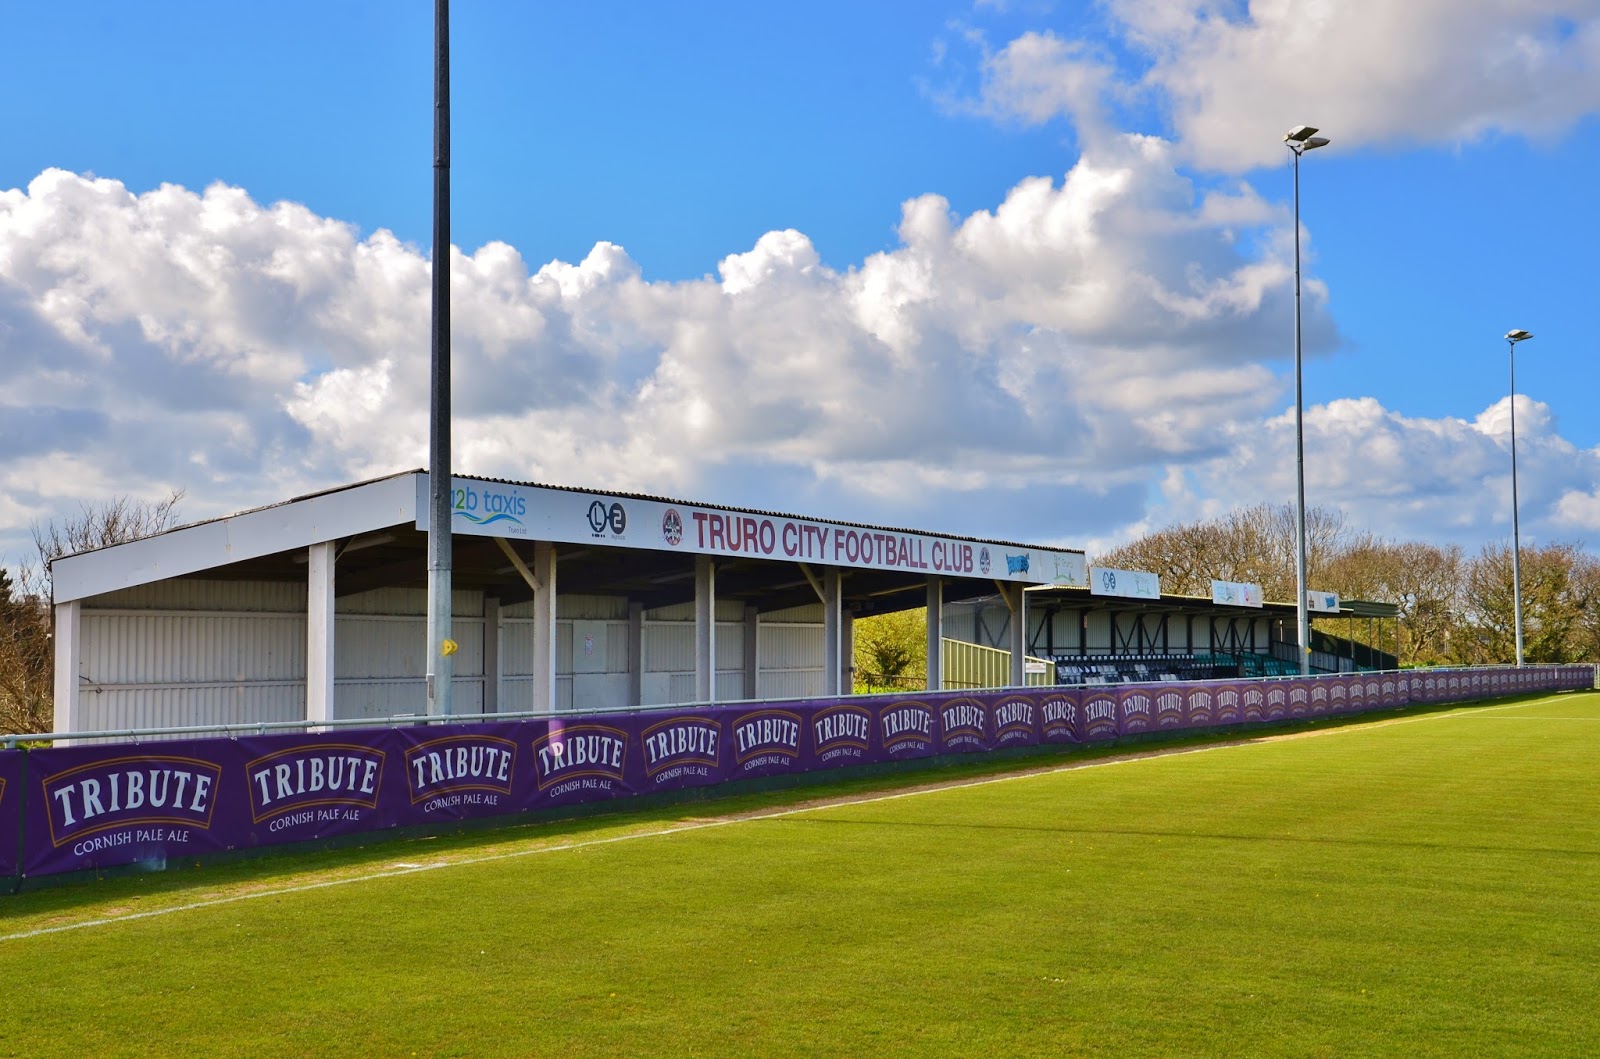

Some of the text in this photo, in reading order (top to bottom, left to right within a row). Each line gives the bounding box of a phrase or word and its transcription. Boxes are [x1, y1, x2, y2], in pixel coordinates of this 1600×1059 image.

[483, 490, 526, 516] taxis
[692, 512, 776, 555] TRURO
[782, 522, 829, 559] CITY
[834, 529, 928, 569] FOOTBALL
[932, 541, 974, 573] CLUB
[1043, 701, 1075, 724] TRIBUTE
[1085, 700, 1115, 723] TRIBUTE
[1123, 695, 1149, 717] TRIBUTE
[1157, 693, 1182, 713] TRIBUTE
[1189, 692, 1211, 711] TRIBUTE
[882, 709, 930, 738] TRIBUTE
[943, 706, 984, 732] TRIBUTE
[996, 703, 1033, 728] TRIBUTE
[736, 719, 798, 753] TRIBUTE
[815, 713, 868, 744] TRIBUTE
[538, 735, 623, 776] TRIBUTE
[646, 726, 718, 764] TRIBUTE
[822, 749, 841, 761] CORNISH
[842, 748, 852, 756] PALE
[889, 742, 907, 754] CORNISH
[412, 746, 511, 789] TRIBUTE
[656, 766, 708, 784] CORNISH PALE ALE
[744, 756, 790, 771] CORNISH PALE ALE
[254, 756, 378, 806] TRIBUTE
[550, 779, 611, 798] CORNISH PALE ALE
[54, 769, 212, 827] TRIBUTE
[424, 793, 498, 813] CORNISH PALE ALE
[269, 809, 360, 832] CORNISH PALE ALE
[74, 828, 189, 856] CORNISH PALE ALE
